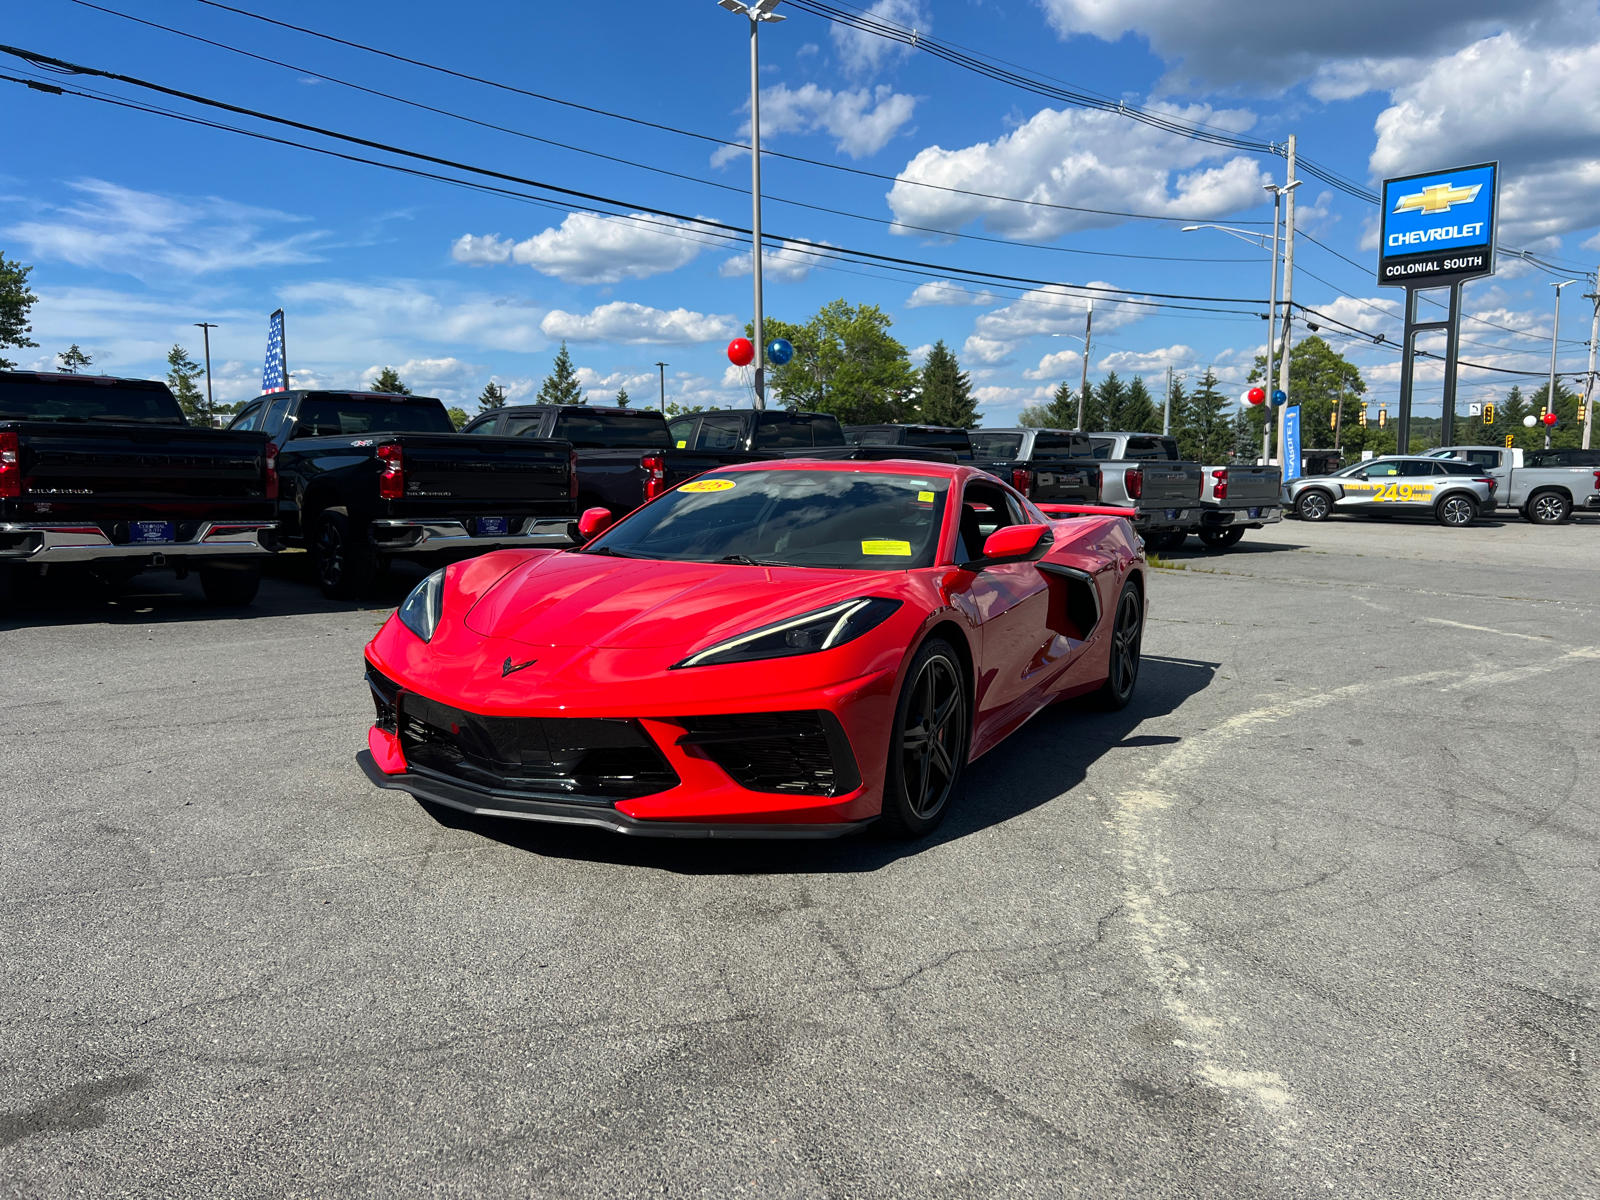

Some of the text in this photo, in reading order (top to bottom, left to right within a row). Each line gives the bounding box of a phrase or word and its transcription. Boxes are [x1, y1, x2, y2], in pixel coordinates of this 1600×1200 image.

[1388, 222, 1484, 247] CHEVROLET
[1386, 256, 1482, 276] COLONIAL SOUTH
[28, 487, 93, 495] SILVERADO
